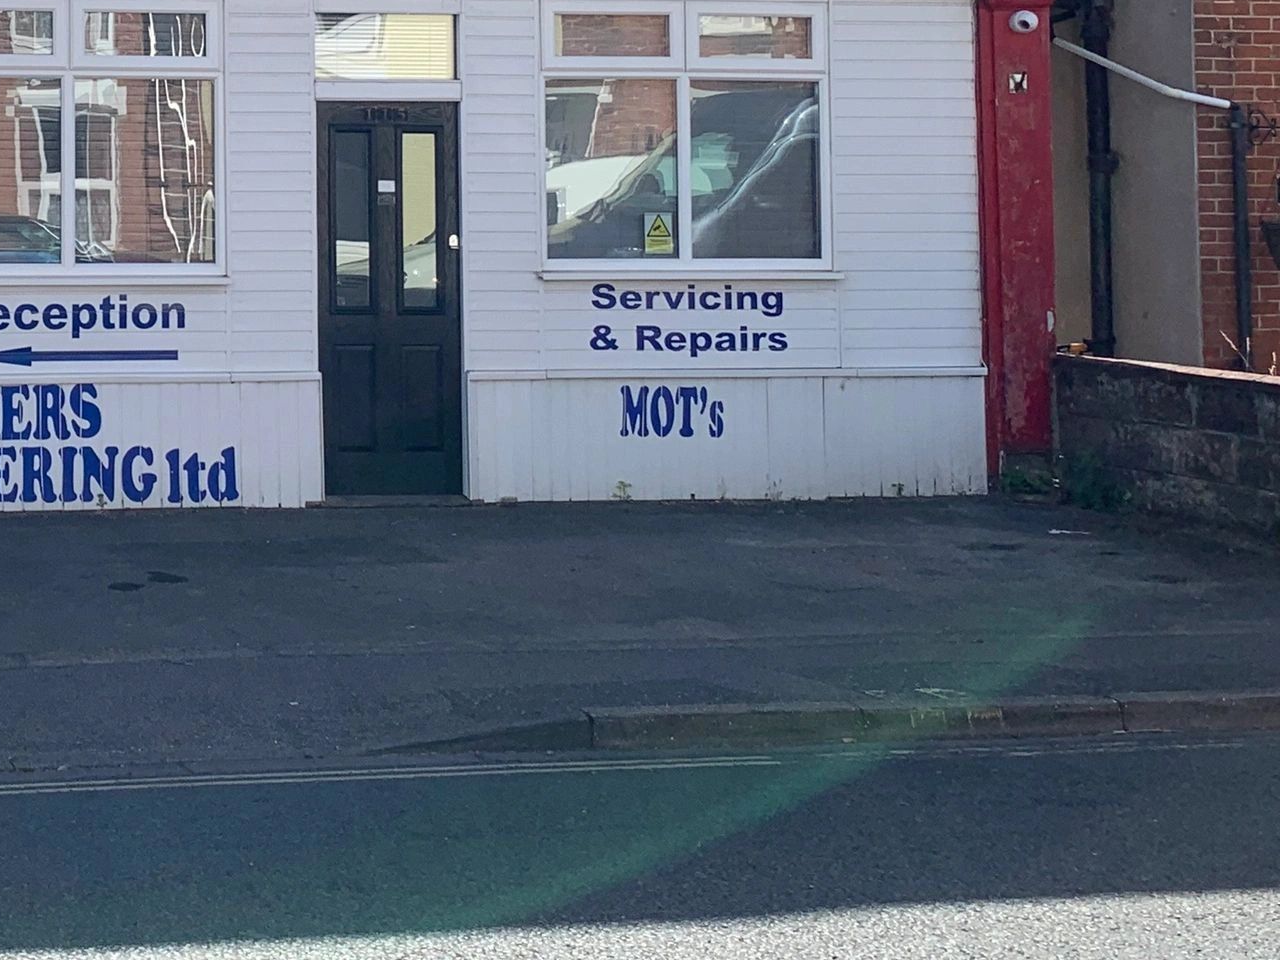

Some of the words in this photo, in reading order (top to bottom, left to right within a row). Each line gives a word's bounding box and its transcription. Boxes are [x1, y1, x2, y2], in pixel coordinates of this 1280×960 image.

[591, 283, 785, 317] Servicing
[589, 326, 618, 351] &
[636, 325, 789, 357] Repairs
[619, 384, 724, 438] MOT's
[165, 446, 239, 504] ltd
